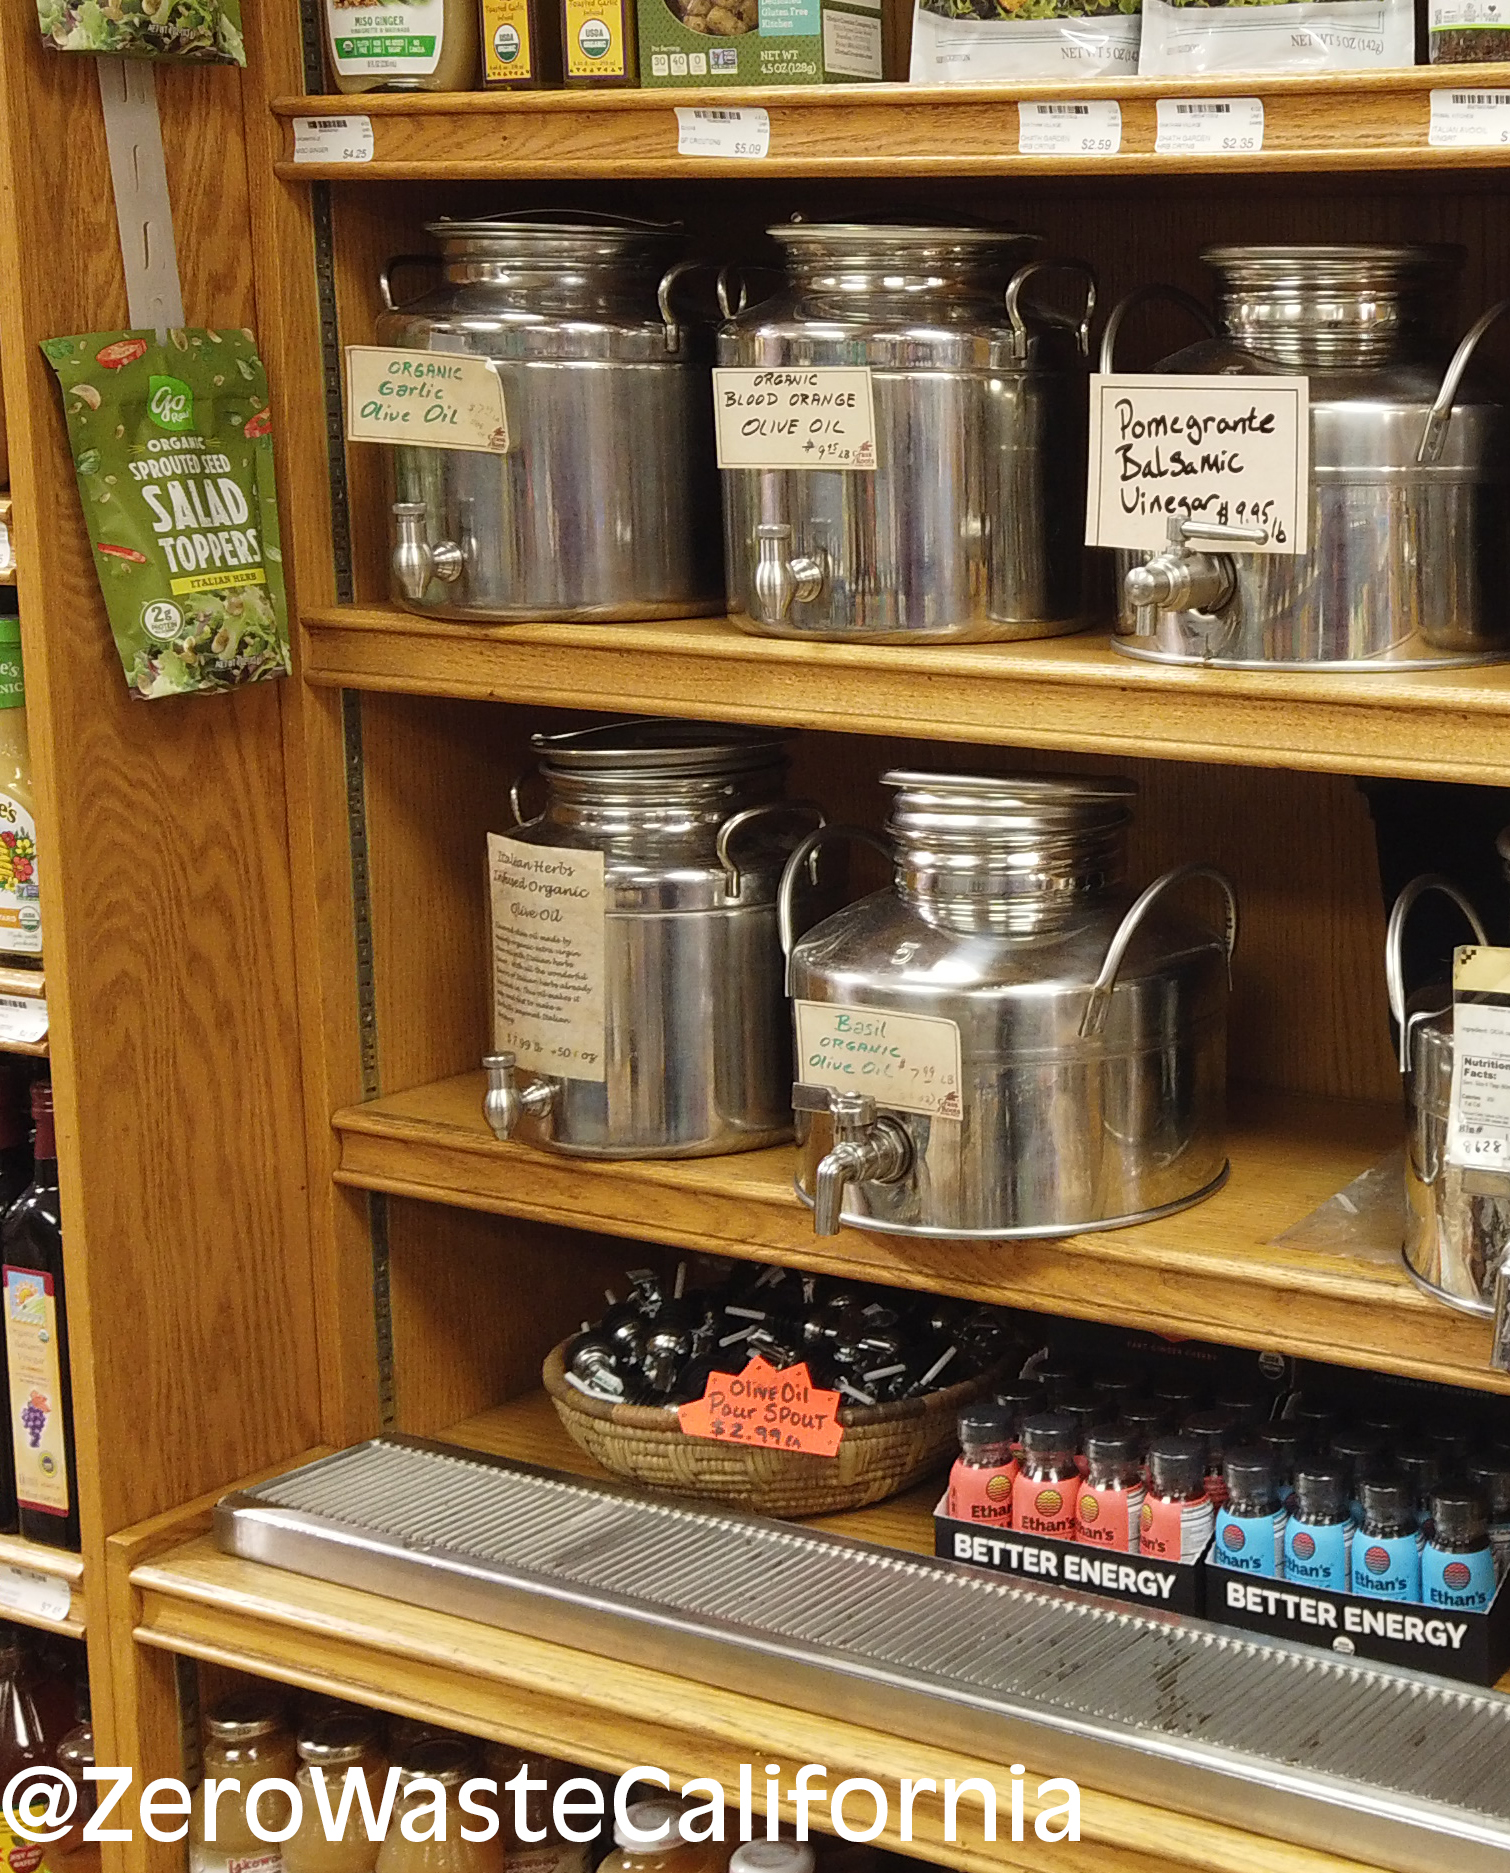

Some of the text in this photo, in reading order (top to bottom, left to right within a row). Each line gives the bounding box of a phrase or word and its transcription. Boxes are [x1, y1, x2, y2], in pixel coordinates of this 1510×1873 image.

[762, 8, 809, 17] Gluten Free
[354, 16, 404, 26] MISO GINGER
[1291, 35, 1313, 47] NET
[654, 56, 665, 66] 30
[761, 50, 798, 60] NET WT
[1062, 47, 1082, 59] NET
[734, 142, 761, 155] $5.09
[1081, 139, 1112, 150] $2.59
[1222, 138, 1253, 149] $2.35
[342, 147, 367, 160] $4.25
[388, 361, 463, 380] ORGANIC
[753, 372, 818, 386] ORGANIC
[378, 381, 443, 400] Garlic
[724, 391, 856, 407] BLOOD ORANGE
[360, 401, 410, 422] Olive
[741, 418, 845, 436] OLIVE OIL
[147, 437, 206, 452] ORGANIC
[128, 454, 230, 480] SPROUTED SEED
[142, 478, 248, 532] SALAD
[158, 528, 262, 573] TOPPERS
[191, 572, 256, 588] ITALIAN HERB
[534, 861, 575, 876] Herbs
[529, 880, 590, 898] Organic
[835, 1015, 887, 1038] Basil
[820, 1037, 901, 1058] ORGANIC
[809, 1054, 855, 1074] Olive
[1464, 1058, 1510, 1070] Nutrition
[1464, 1068, 1497, 1080] Facts:
[708, 1391, 757, 1420] Pour
[1021, 1515, 1075, 1532] Ethan's
[954, 1532, 1176, 1599] BETTER ENERGY
[1355, 1571, 1406, 1591] Ethan's
[1431, 1588, 1486, 1607] Ethan's
[1227, 1581, 1467, 1649] BETTER ENERGY
